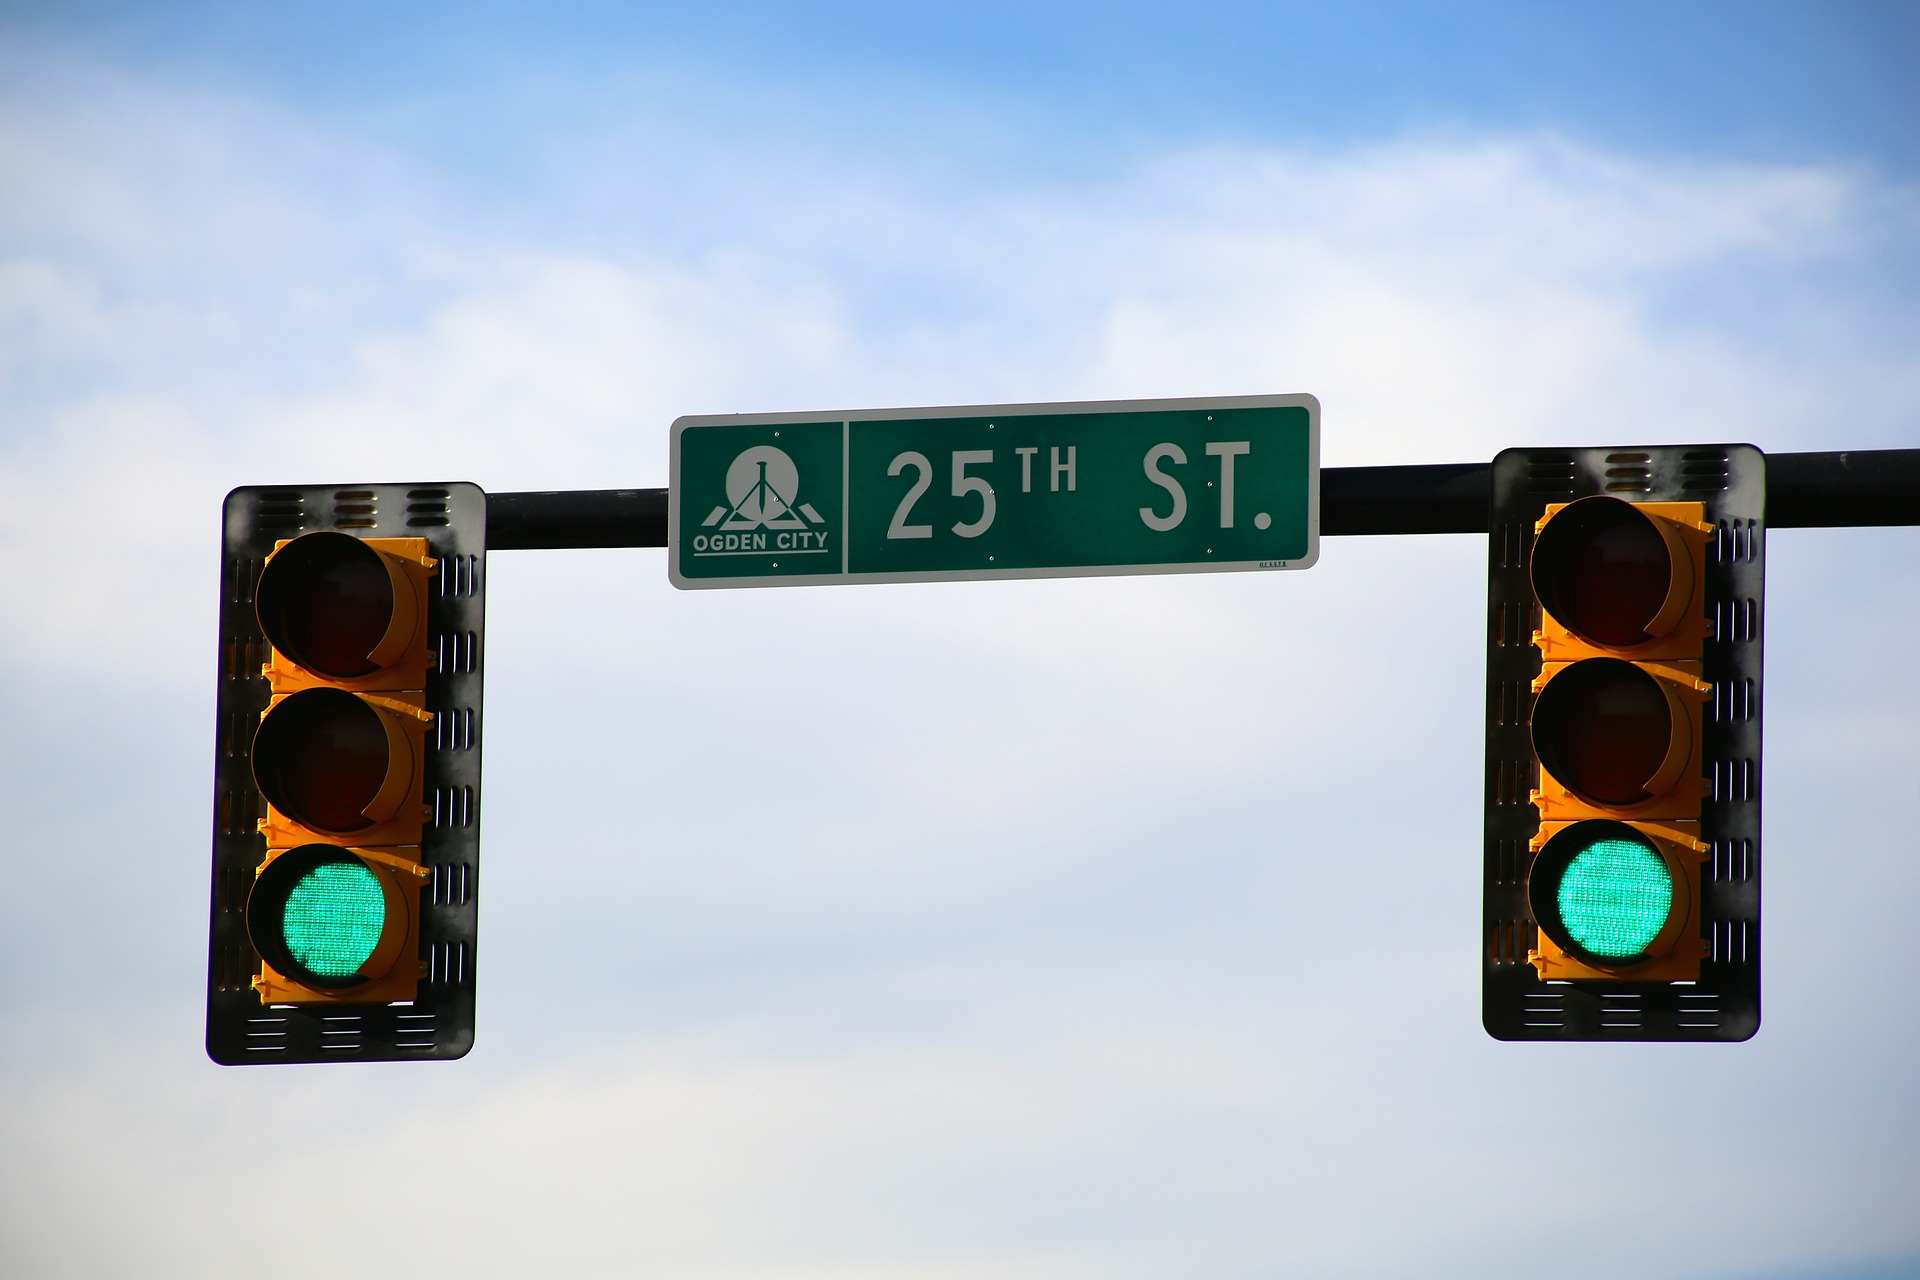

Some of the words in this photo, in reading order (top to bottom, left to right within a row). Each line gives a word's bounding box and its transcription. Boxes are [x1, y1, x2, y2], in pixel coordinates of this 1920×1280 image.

[886, 445, 1077, 539] 25TH
[1139, 440, 1272, 532] ST.
[693, 533, 766, 551] OGDEN
[776, 531, 829, 549] CITY
